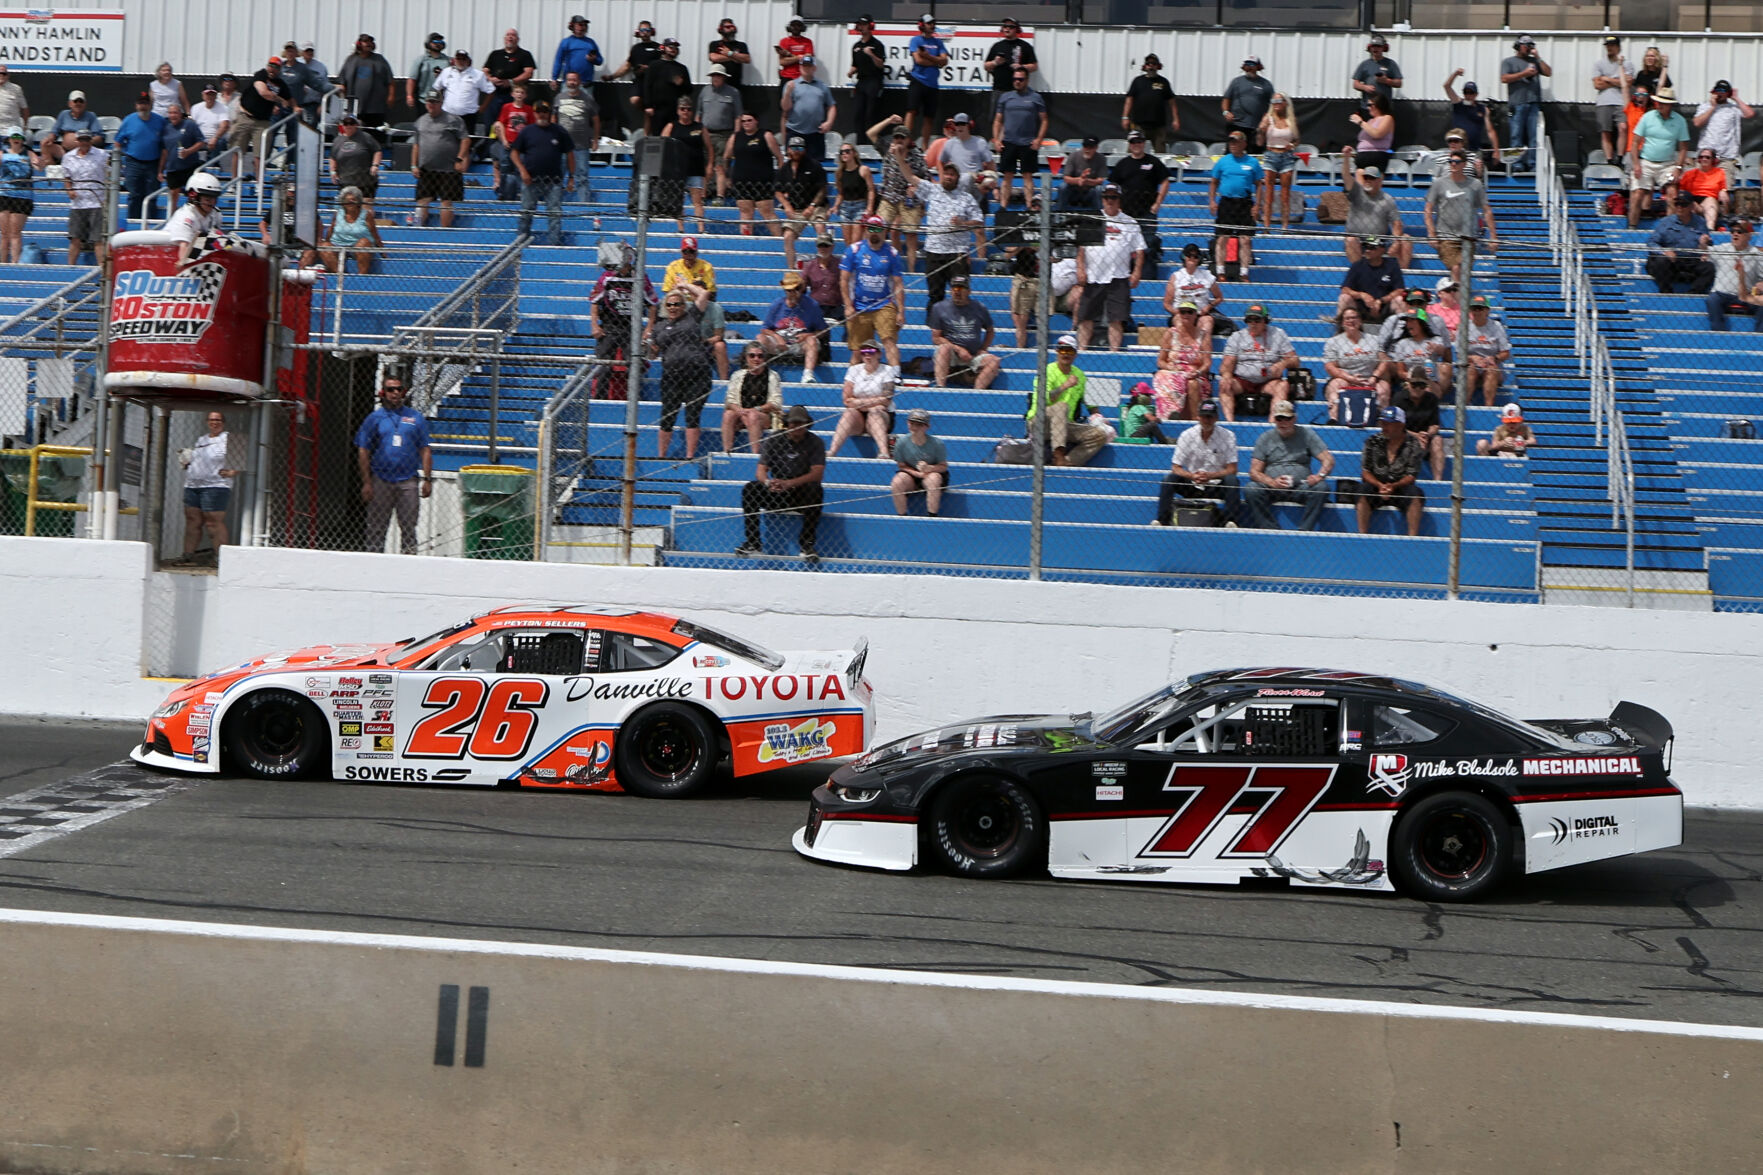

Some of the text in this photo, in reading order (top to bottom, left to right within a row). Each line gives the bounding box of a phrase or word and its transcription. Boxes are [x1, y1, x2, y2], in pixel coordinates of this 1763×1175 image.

[37, 27, 102, 40] HAMLIN
[115, 271, 201, 296] SOUTH
[112, 297, 211, 322] BOSTON
[563, 674, 846, 702] Danville TOYOTA
[341, 725, 360, 733] OMP
[402, 676, 550, 761] 26
[187, 727, 208, 735] SIMPSON
[767, 729, 824, 750] WAKG
[345, 766, 428, 781] SOWERS
[1414, 758, 1641, 779] Mike Bledsole MECHANICAL
[1134, 762, 1339, 859] 77
[1574, 815, 1618, 830] DIGITAL
[1576, 828, 1620, 838] REPAIR
